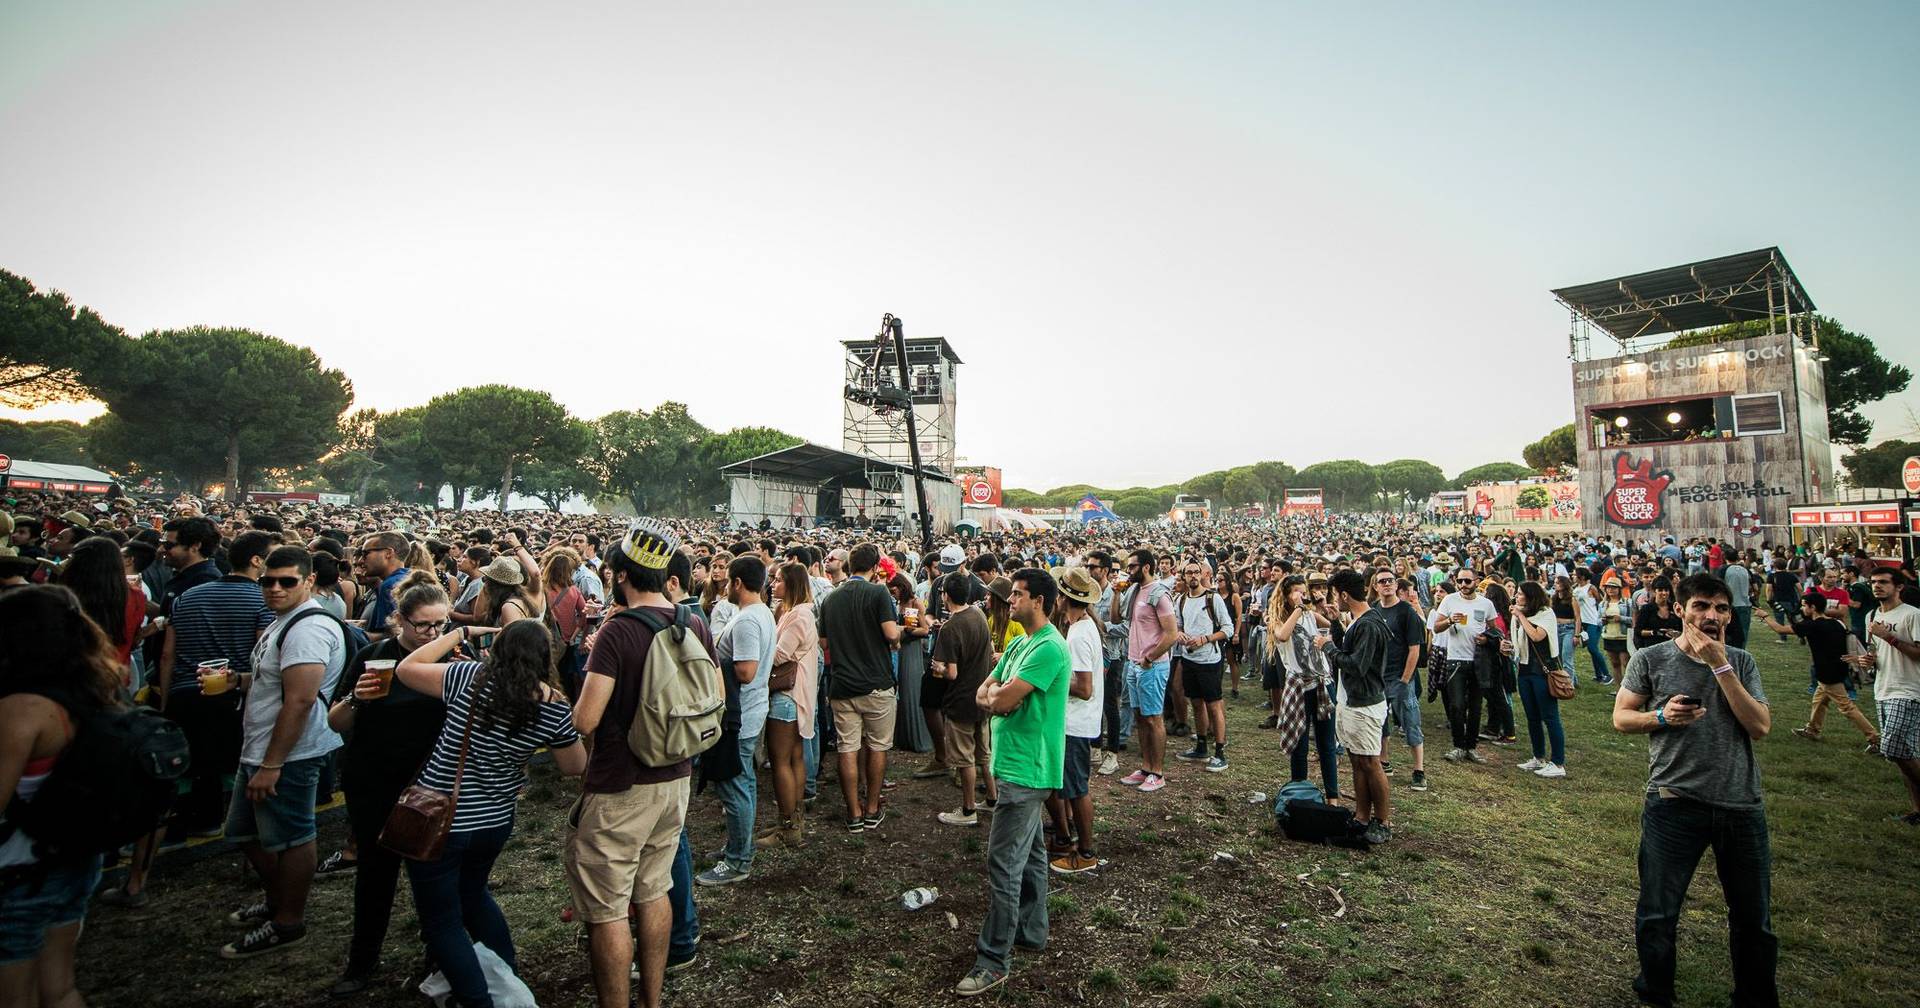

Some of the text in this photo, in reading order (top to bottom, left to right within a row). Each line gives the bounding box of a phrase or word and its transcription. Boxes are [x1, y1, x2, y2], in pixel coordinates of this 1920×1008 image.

[1576, 344, 1786, 383] SUPER BOCK SUPER ROCK
[1720, 481, 1749, 492] SOL
[1753, 479, 1766, 489] &
[1616, 487, 1647, 497] SUPER
[1617, 495, 1646, 504] BOCK
[1621, 503, 1654, 512] SUPER
[1624, 511, 1653, 520] ROCK
